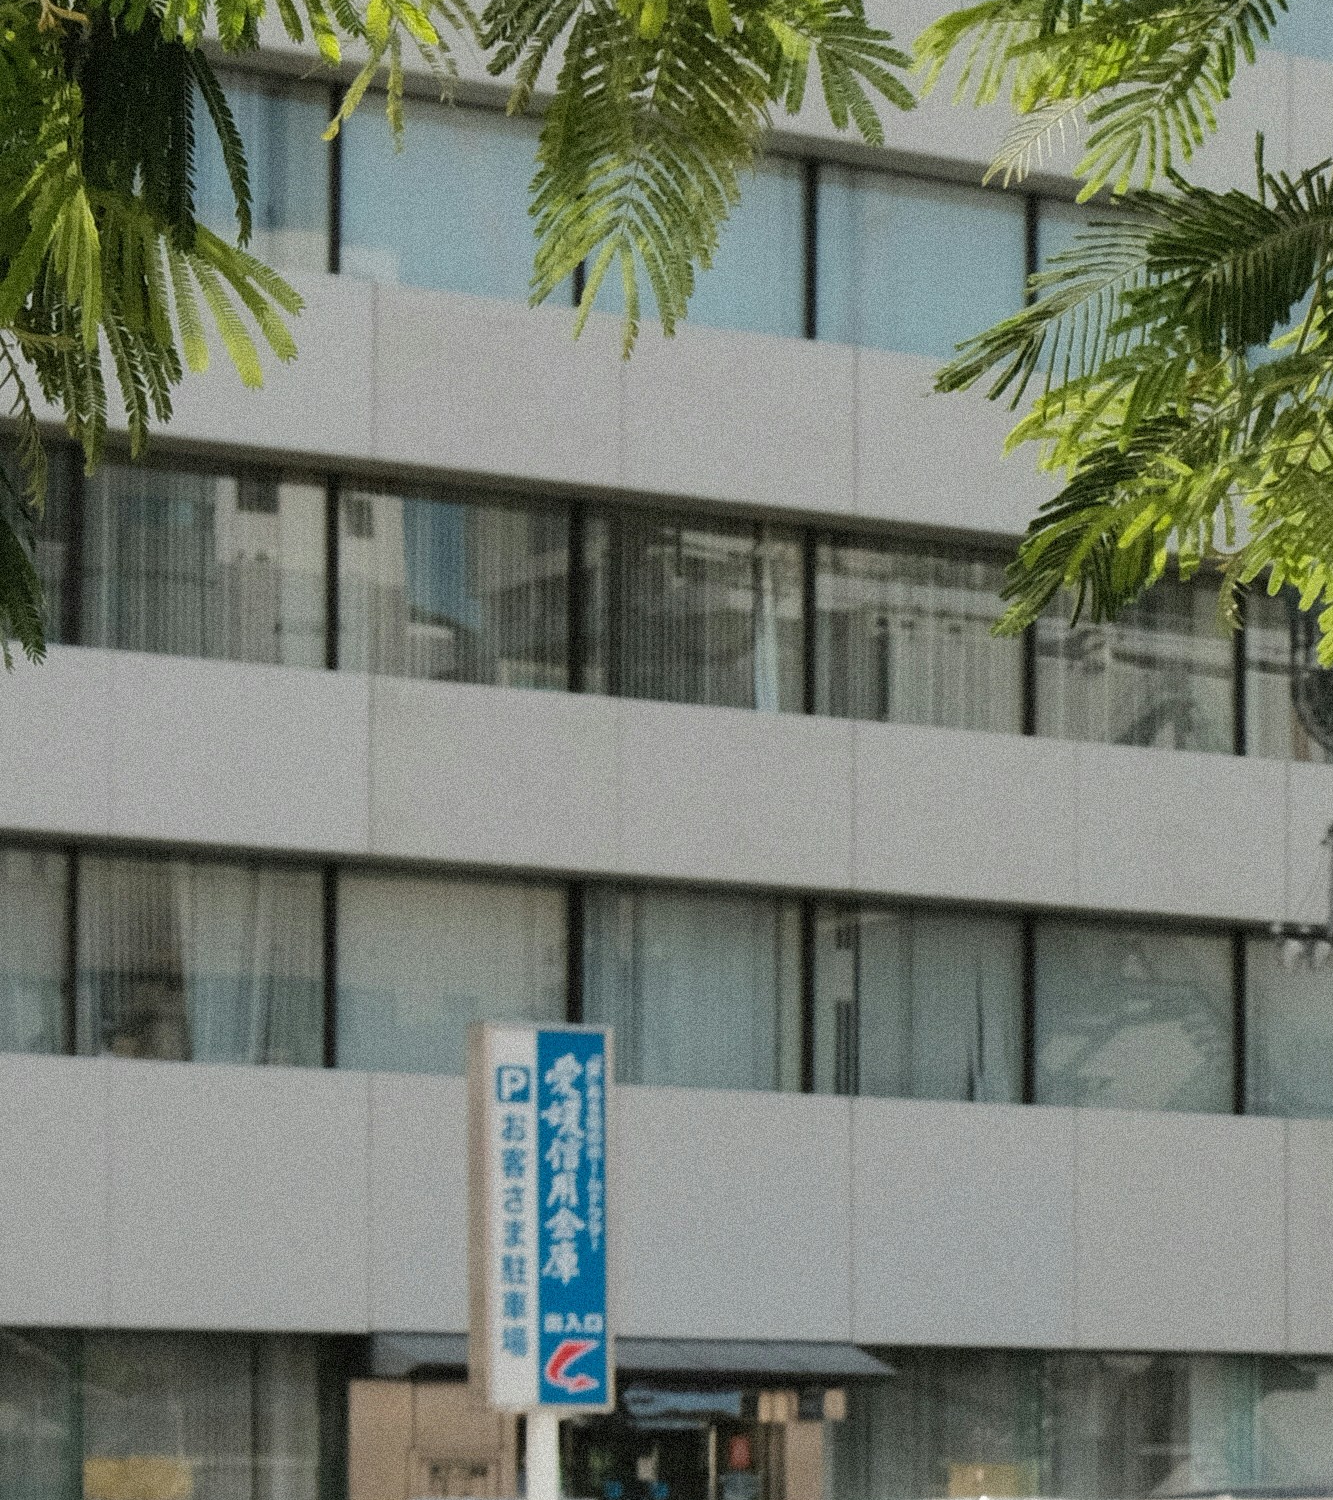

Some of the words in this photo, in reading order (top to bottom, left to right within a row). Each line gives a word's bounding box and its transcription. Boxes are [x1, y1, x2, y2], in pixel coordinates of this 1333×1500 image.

[500, 1068, 528, 1101] P
[541, 1051, 585, 1287] 愛媛信用金庫
[501, 1112, 530, 1358] お客さま駐車場
